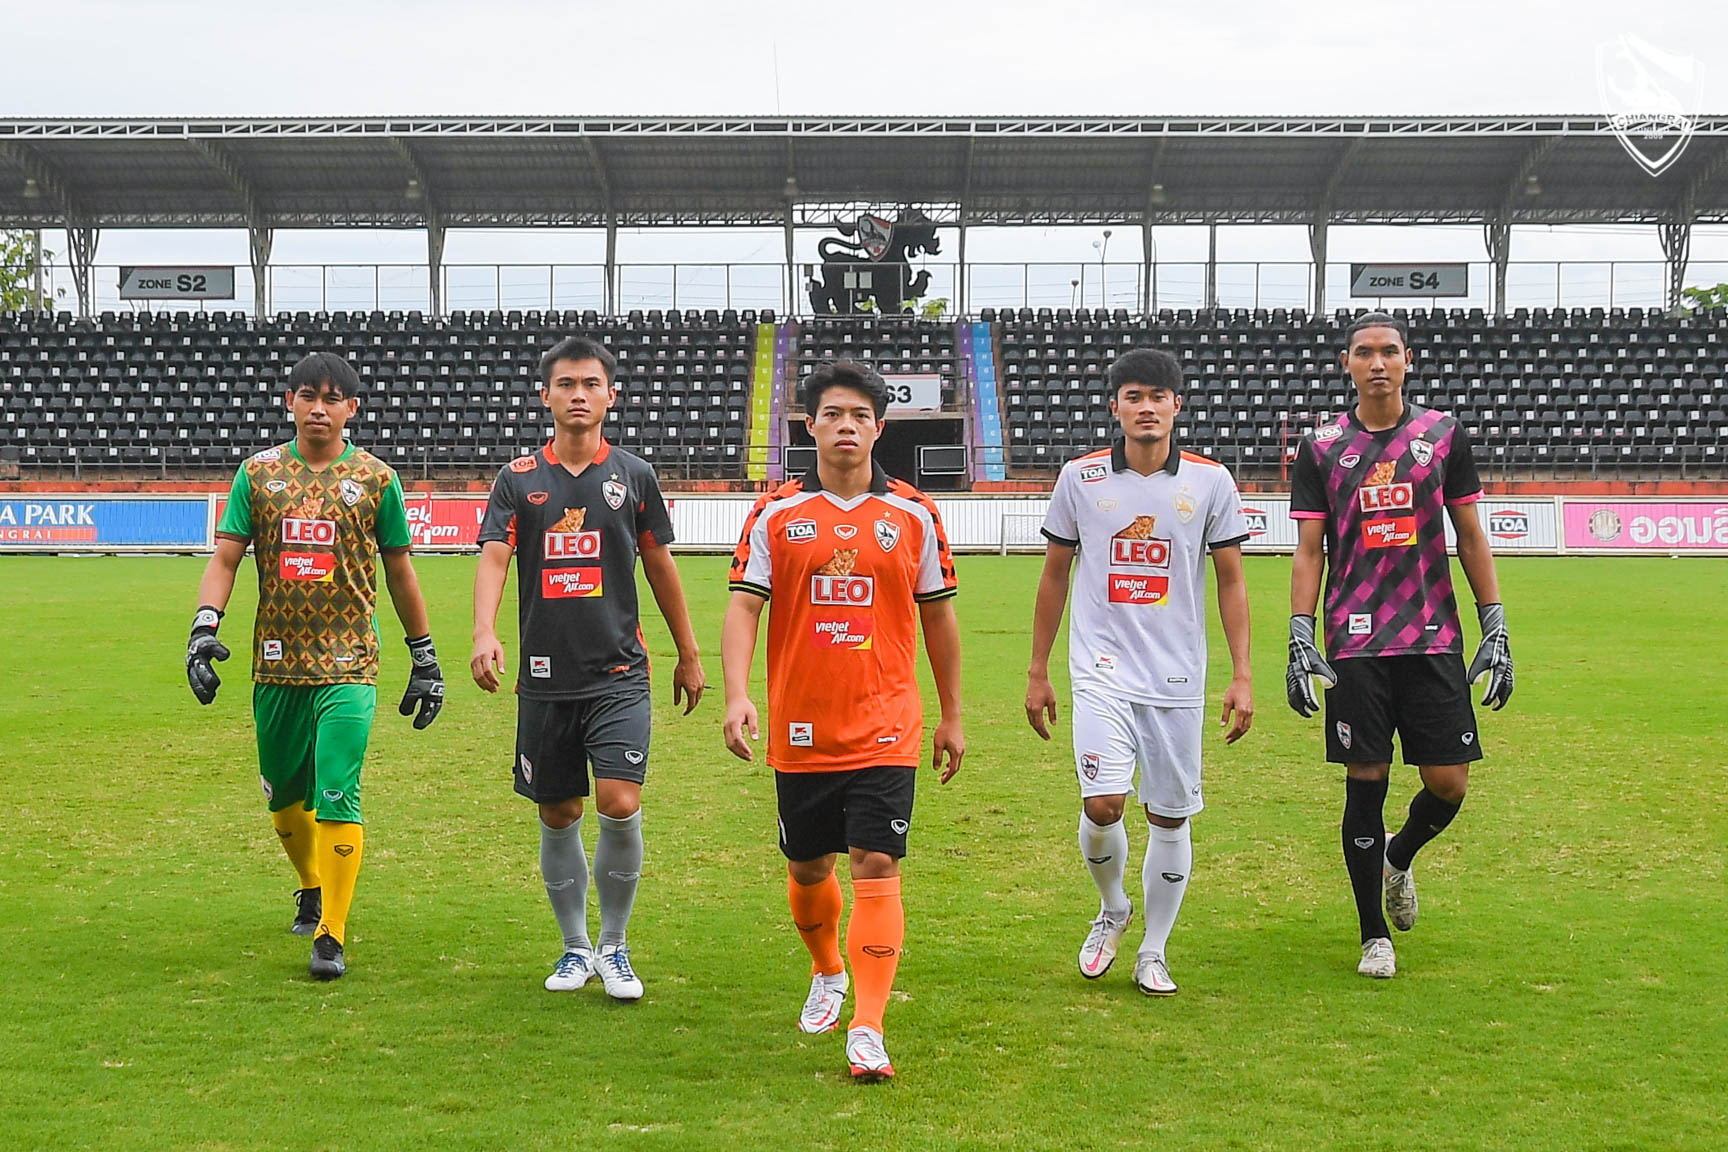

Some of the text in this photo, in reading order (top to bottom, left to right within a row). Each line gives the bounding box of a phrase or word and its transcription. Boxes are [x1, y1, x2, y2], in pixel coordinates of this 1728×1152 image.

[138, 274, 207, 292] ZONE S2
[1369, 272, 1440, 290] ZONE S4
[1081, 467, 1107, 479] TOA
[1363, 486, 1410, 509] LEO
[0, 504, 95, 525] A PARK
[1246, 515, 1266, 529] OA
[286, 523, 332, 541] LEO
[788, 525, 815, 537] TOA
[1491, 518, 1527, 531] TOA
[549, 534, 597, 556] LEO
[1115, 541, 1166, 564] LEO
[815, 578, 869, 602] LEO
